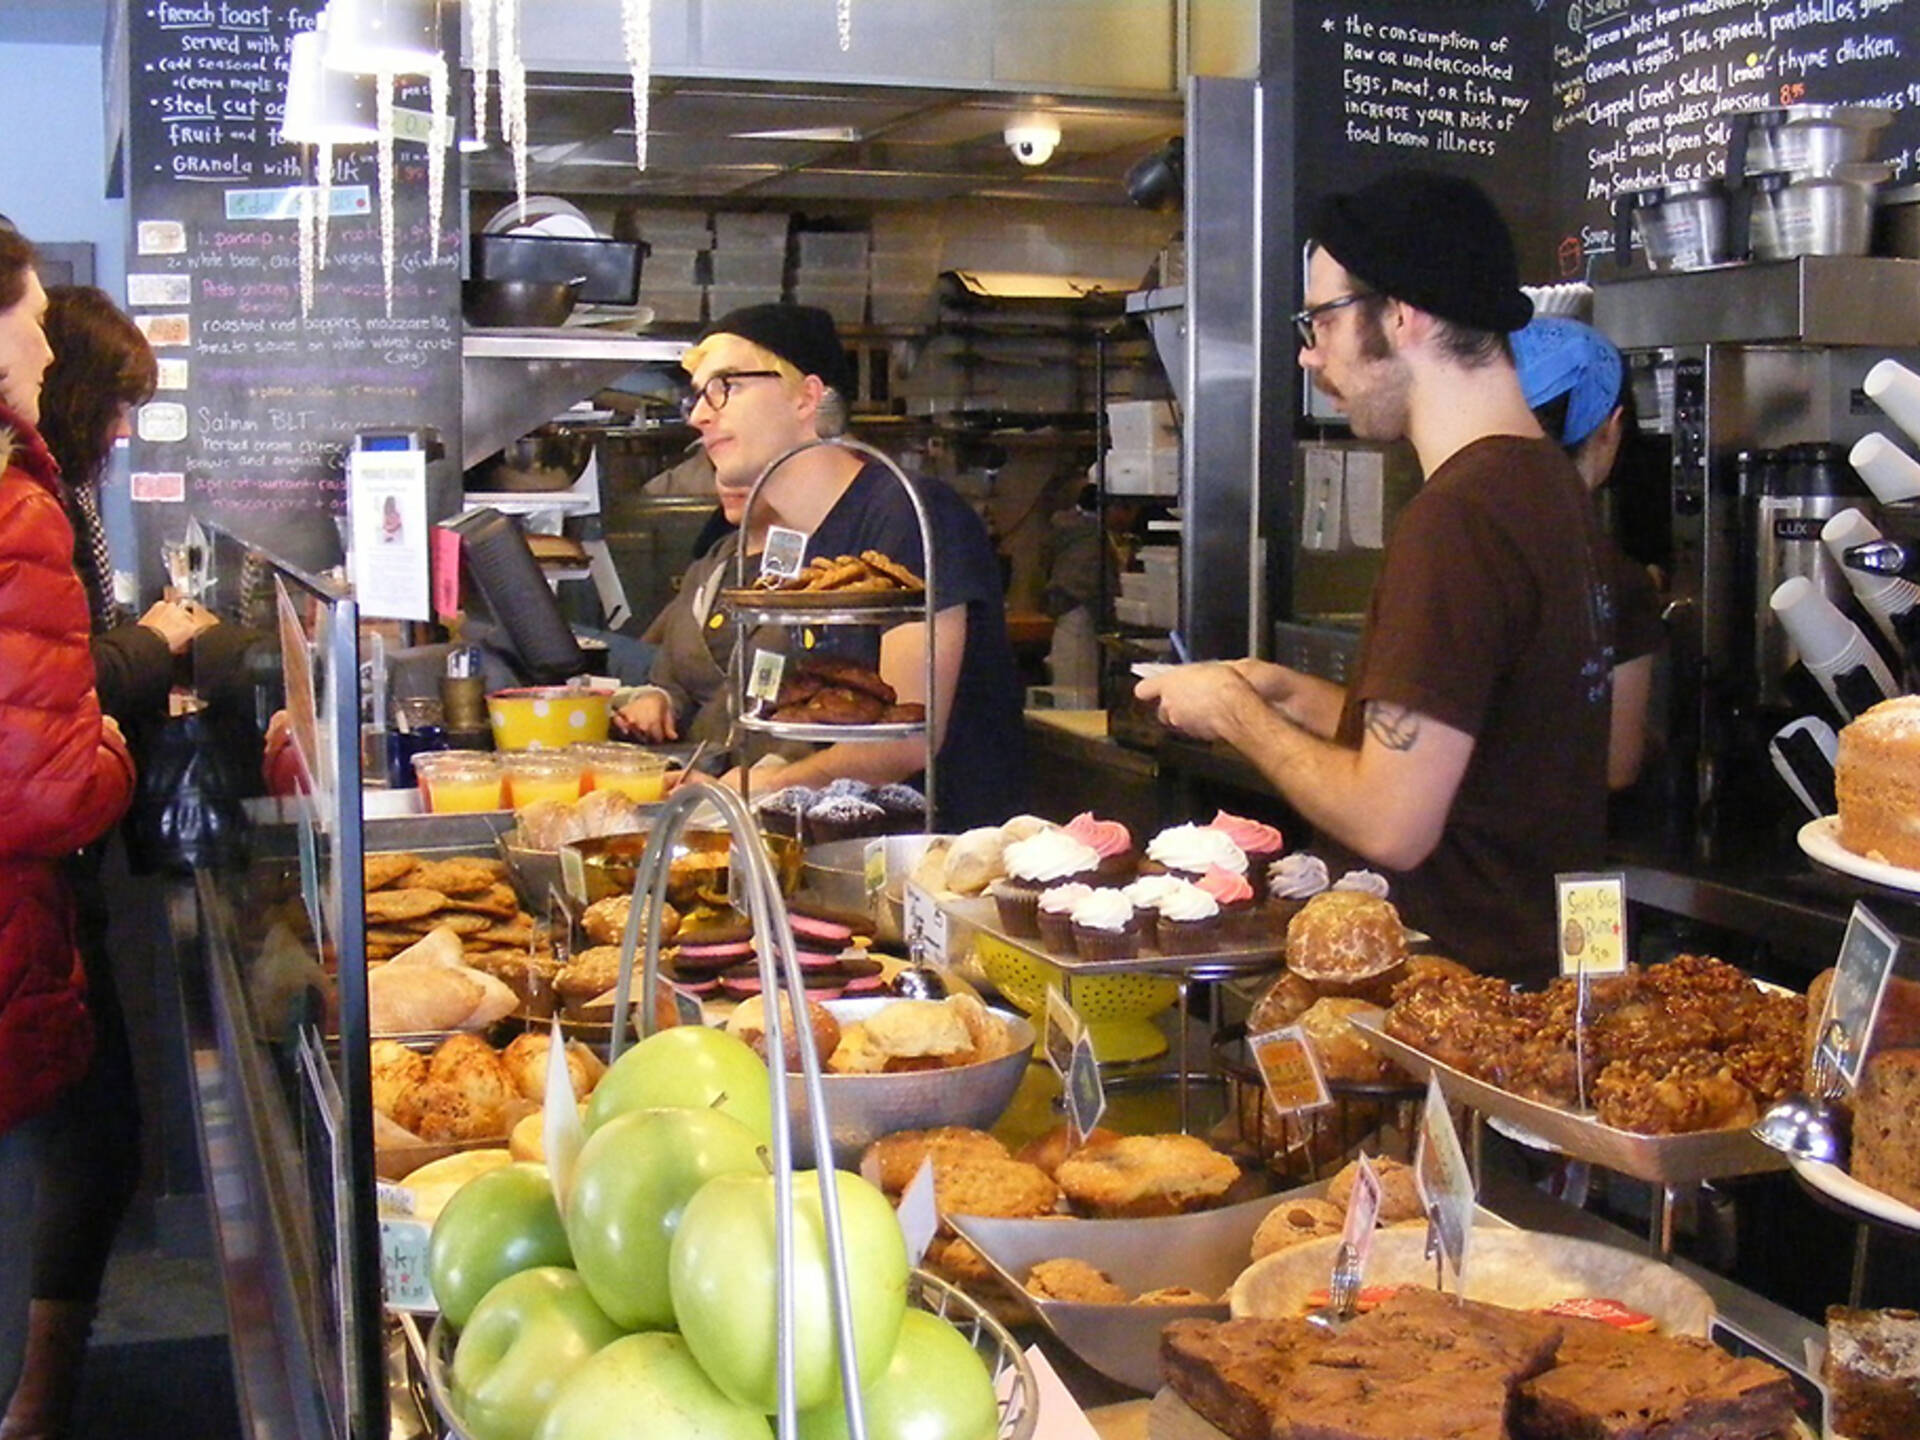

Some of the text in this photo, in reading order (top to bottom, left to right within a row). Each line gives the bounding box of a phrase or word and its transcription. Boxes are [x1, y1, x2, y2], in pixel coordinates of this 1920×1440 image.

[219, 1, 272, 26] toast
[1345, 13, 1510, 53] the consumption of
[1713, 10, 1767, 50] spinach,
[182, 35, 240, 54] served
[247, 35, 280, 53] with
[1343, 42, 1374, 61] Raw
[1343, 69, 1388, 96] Eggs,
[1392, 77, 1434, 102] meat,
[1464, 80, 1496, 106] fish
[1501, 95, 1530, 115] may
[223, 98, 260, 115] cut
[1585, 90, 1635, 128] Chopped
[1496, 113, 1515, 132] of
[230, 128, 256, 142] and
[1345, 120, 1381, 145] food
[1436, 130, 1497, 156] illness
[264, 157, 302, 177] with
[203, 319, 265, 333] roasted
[270, 318, 296, 332] red
[415, 337, 456, 350] crust
[199, 406, 258, 434] Salmon
[268, 408, 316, 432] BLT
[239, 454, 267, 466] and
